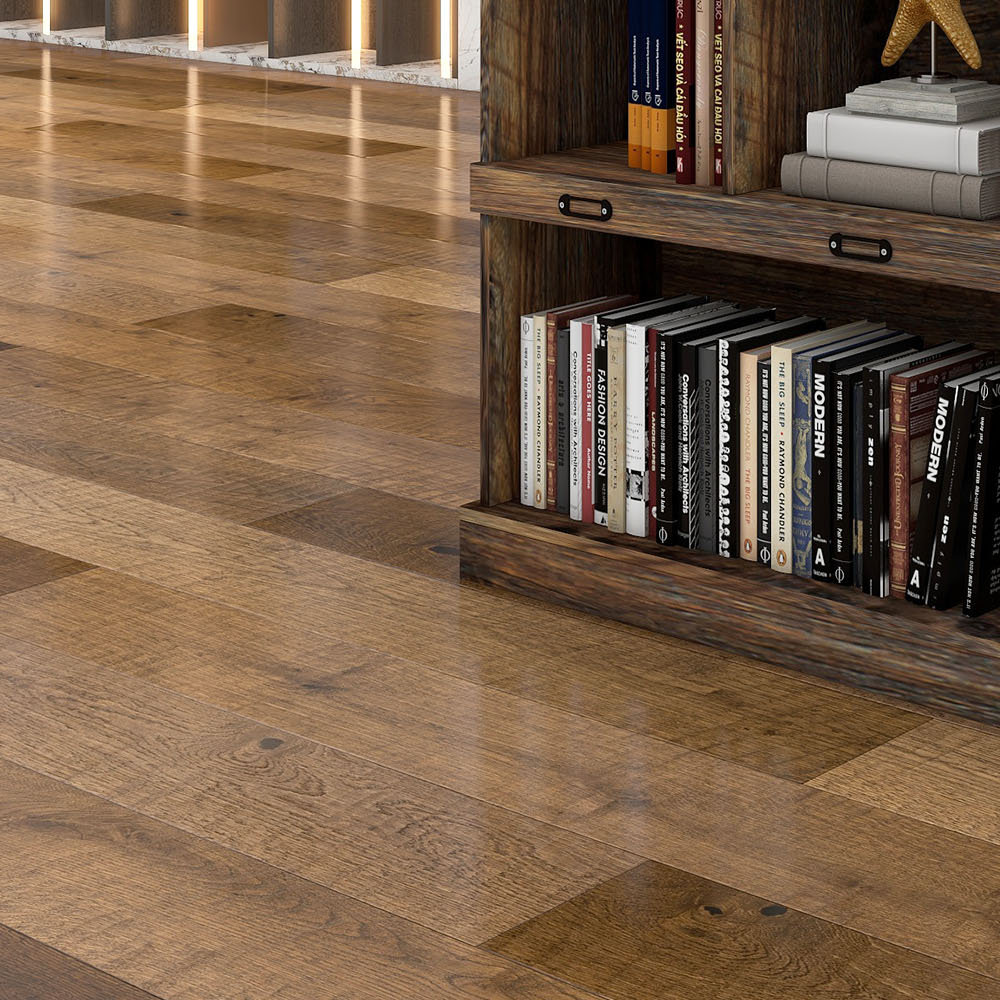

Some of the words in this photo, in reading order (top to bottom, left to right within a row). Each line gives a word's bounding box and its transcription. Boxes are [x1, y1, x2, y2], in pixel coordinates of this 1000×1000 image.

[597, 368, 606, 426] FASHION
[682, 374, 690, 441] Conversations
[704, 379, 712, 445] Conversations
[814, 373, 826, 459] MODERN
[597, 427, 606, 477] DESIGN
[682, 443, 690, 464] with
[704, 447, 712, 468] with
[926, 396, 949, 483] MODERN
[682, 465, 690, 514] Architects
[704, 470, 712, 518] Architects
[940, 514, 950, 545] zen
